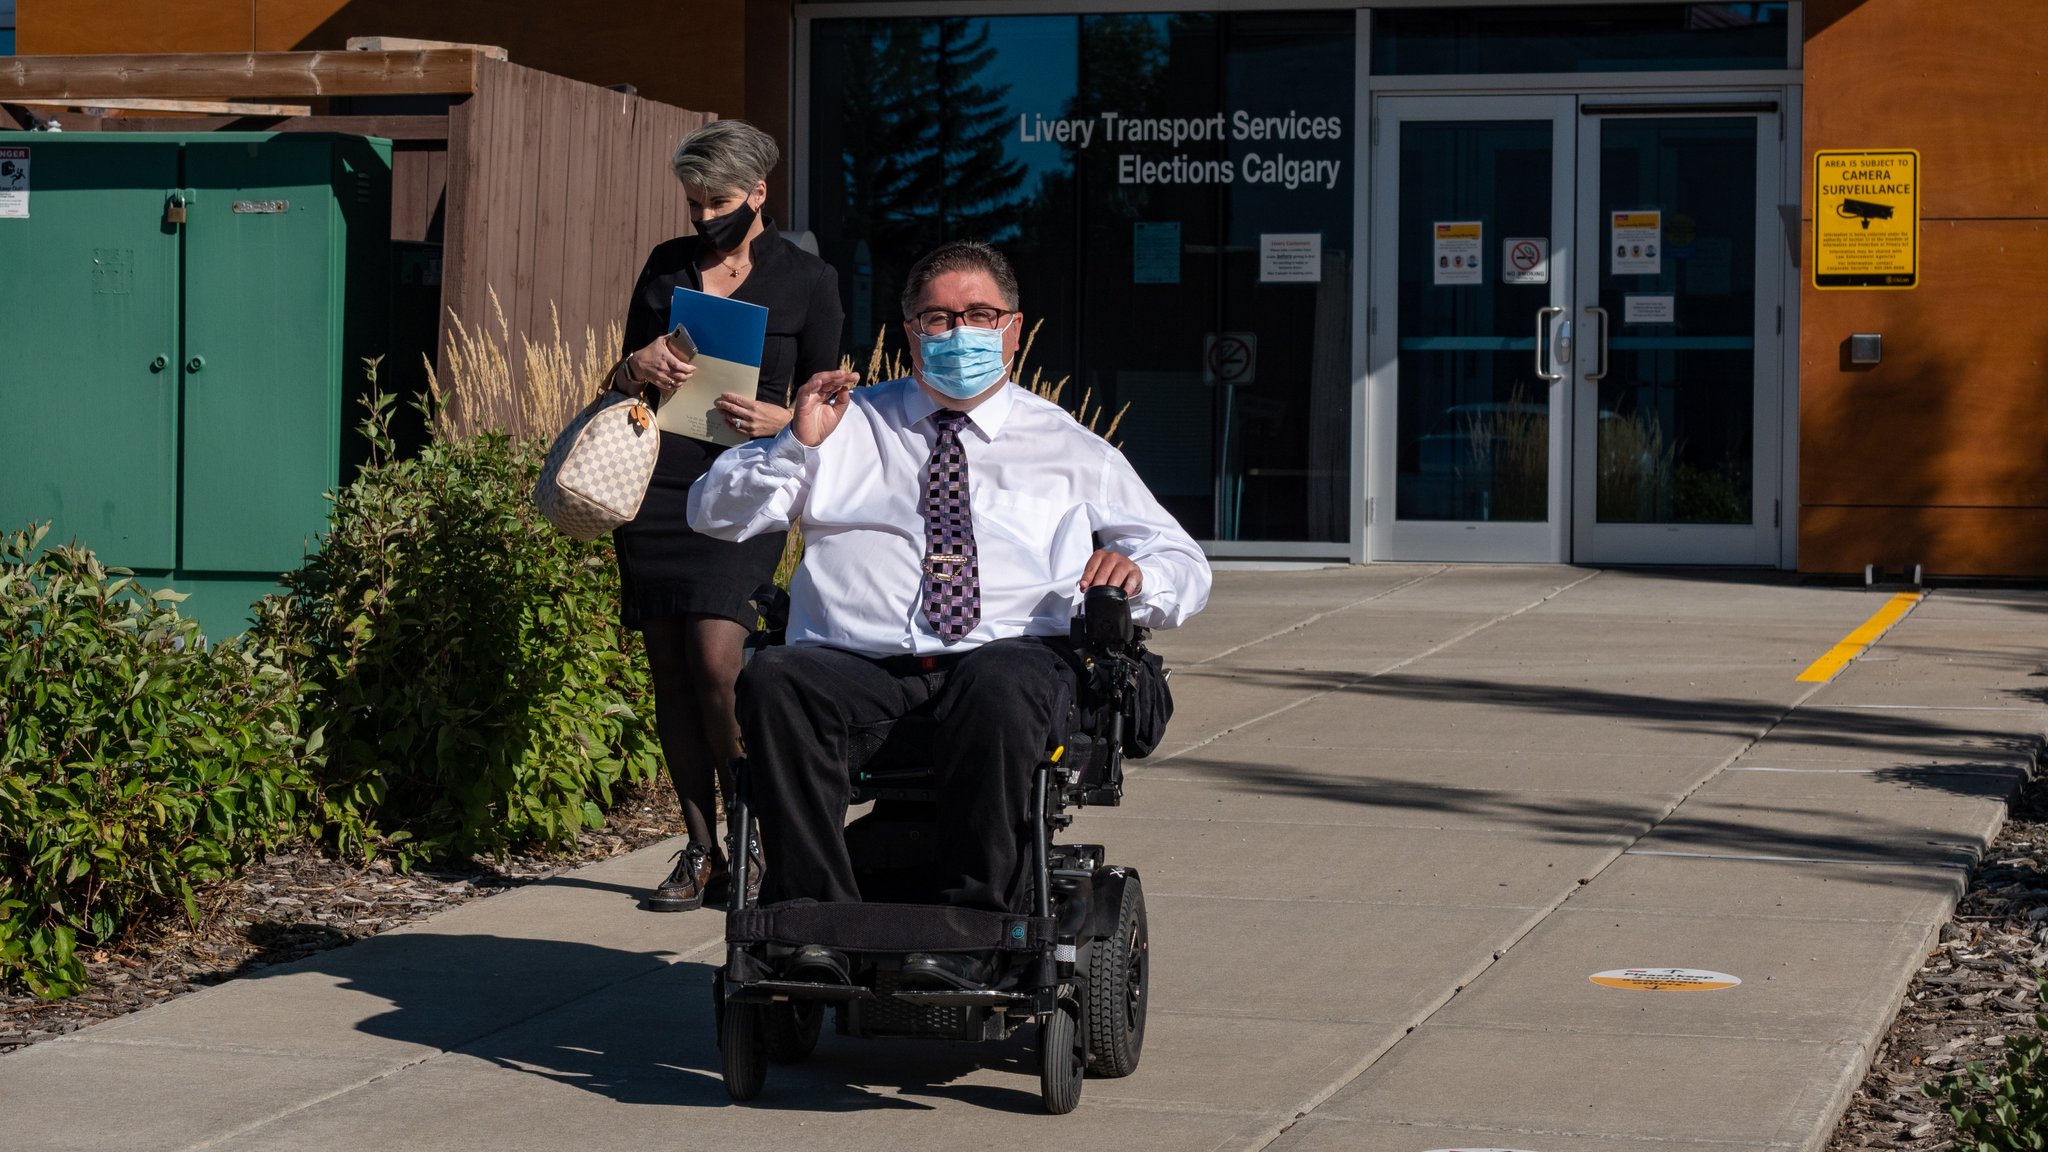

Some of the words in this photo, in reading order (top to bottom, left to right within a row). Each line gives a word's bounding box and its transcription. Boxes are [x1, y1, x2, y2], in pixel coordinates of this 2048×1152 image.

[1020, 112, 1094, 148] Livery
[1101, 112, 1225, 148] Transport
[1232, 110, 1341, 140] Services
[1825, 160, 1846, 168] AREA
[1860, 159, 1894, 167] SUBJECT
[1898, 159, 1908, 167] TO
[1118, 154, 1234, 184] Elections
[1242, 152, 1341, 190] Calgary
[1842, 170, 1891, 181] CAMERA
[1823, 184, 1910, 196] SURVEILLANCE
